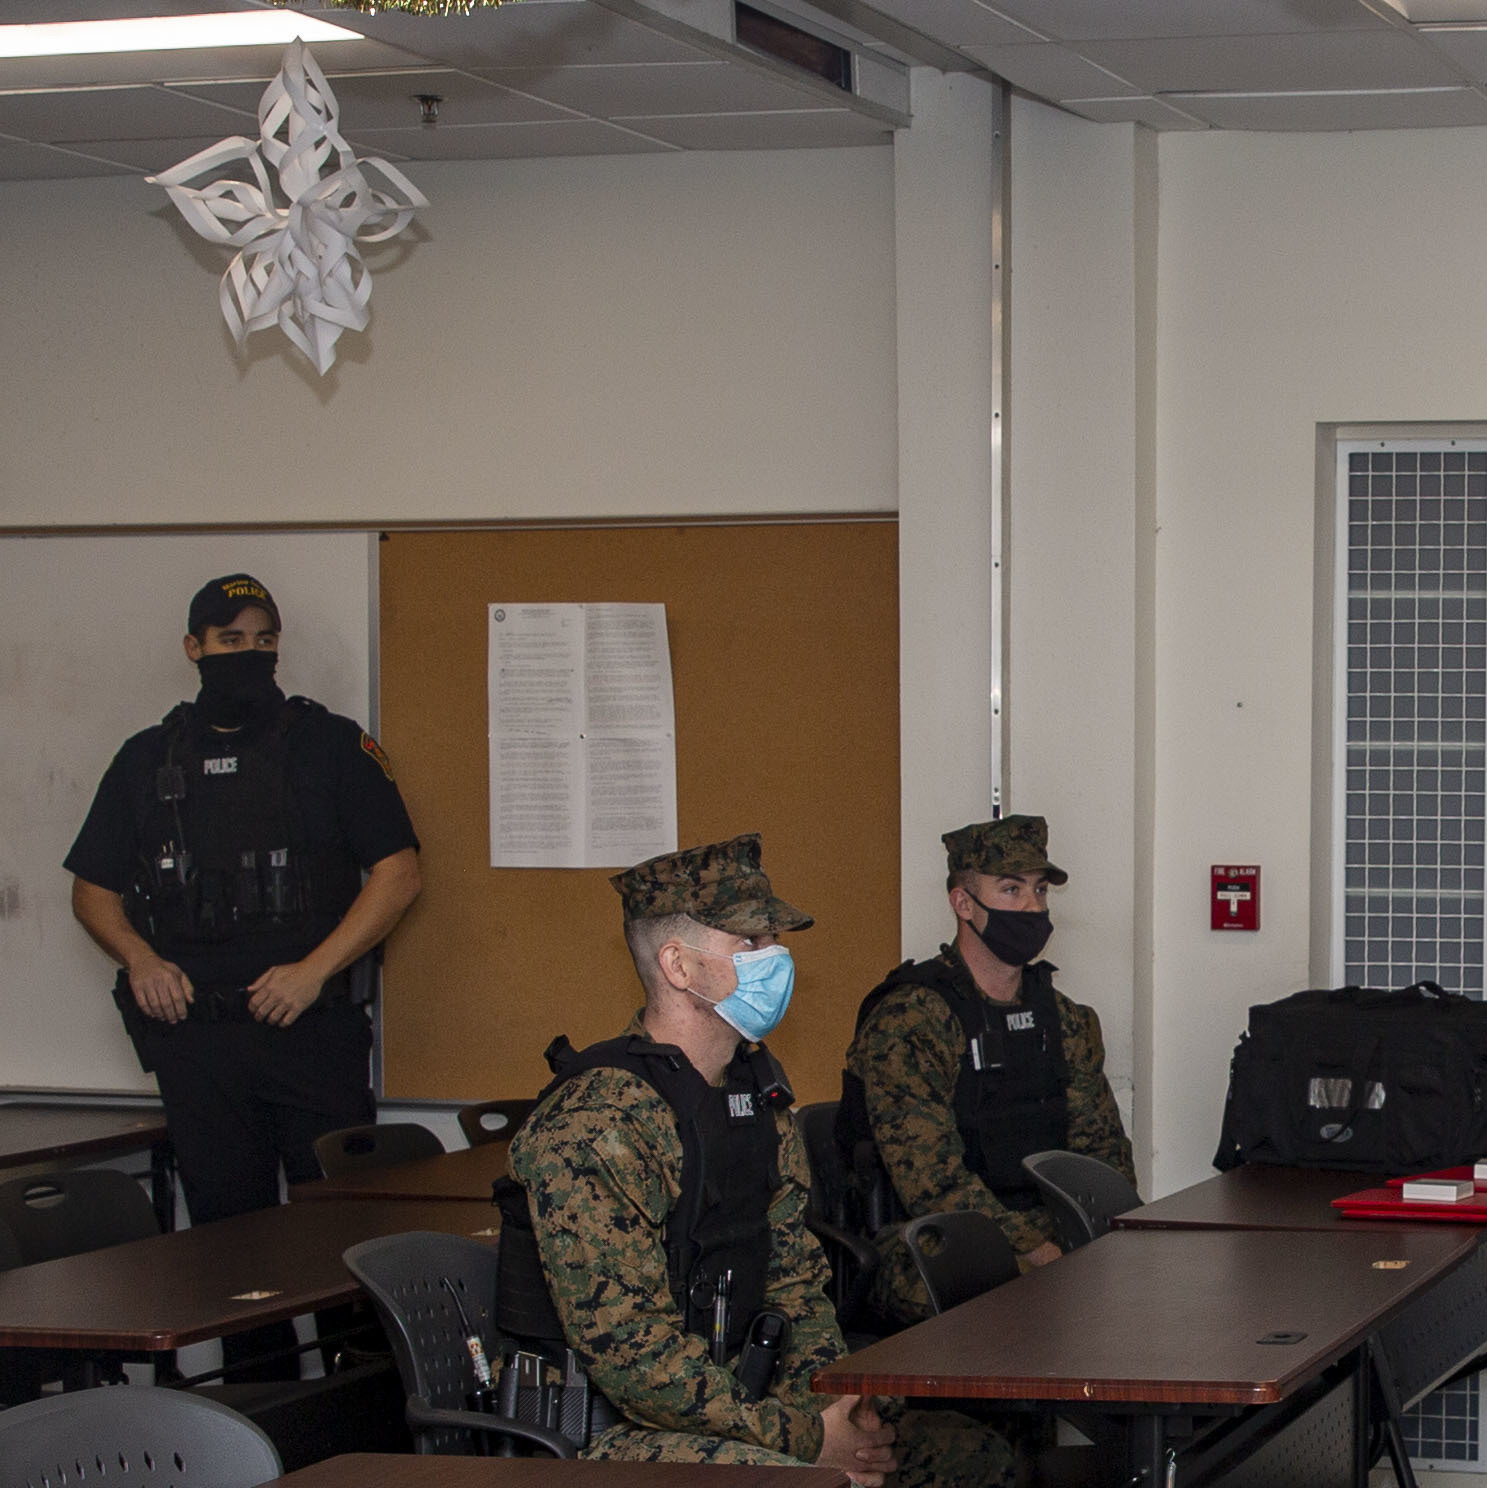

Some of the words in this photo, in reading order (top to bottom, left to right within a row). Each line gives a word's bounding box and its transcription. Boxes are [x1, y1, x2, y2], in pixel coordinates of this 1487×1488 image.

[203, 757, 238, 775] POLICE
[1006, 1011, 1035, 1031] POLICE
[728, 1094, 754, 1117] POLICE
